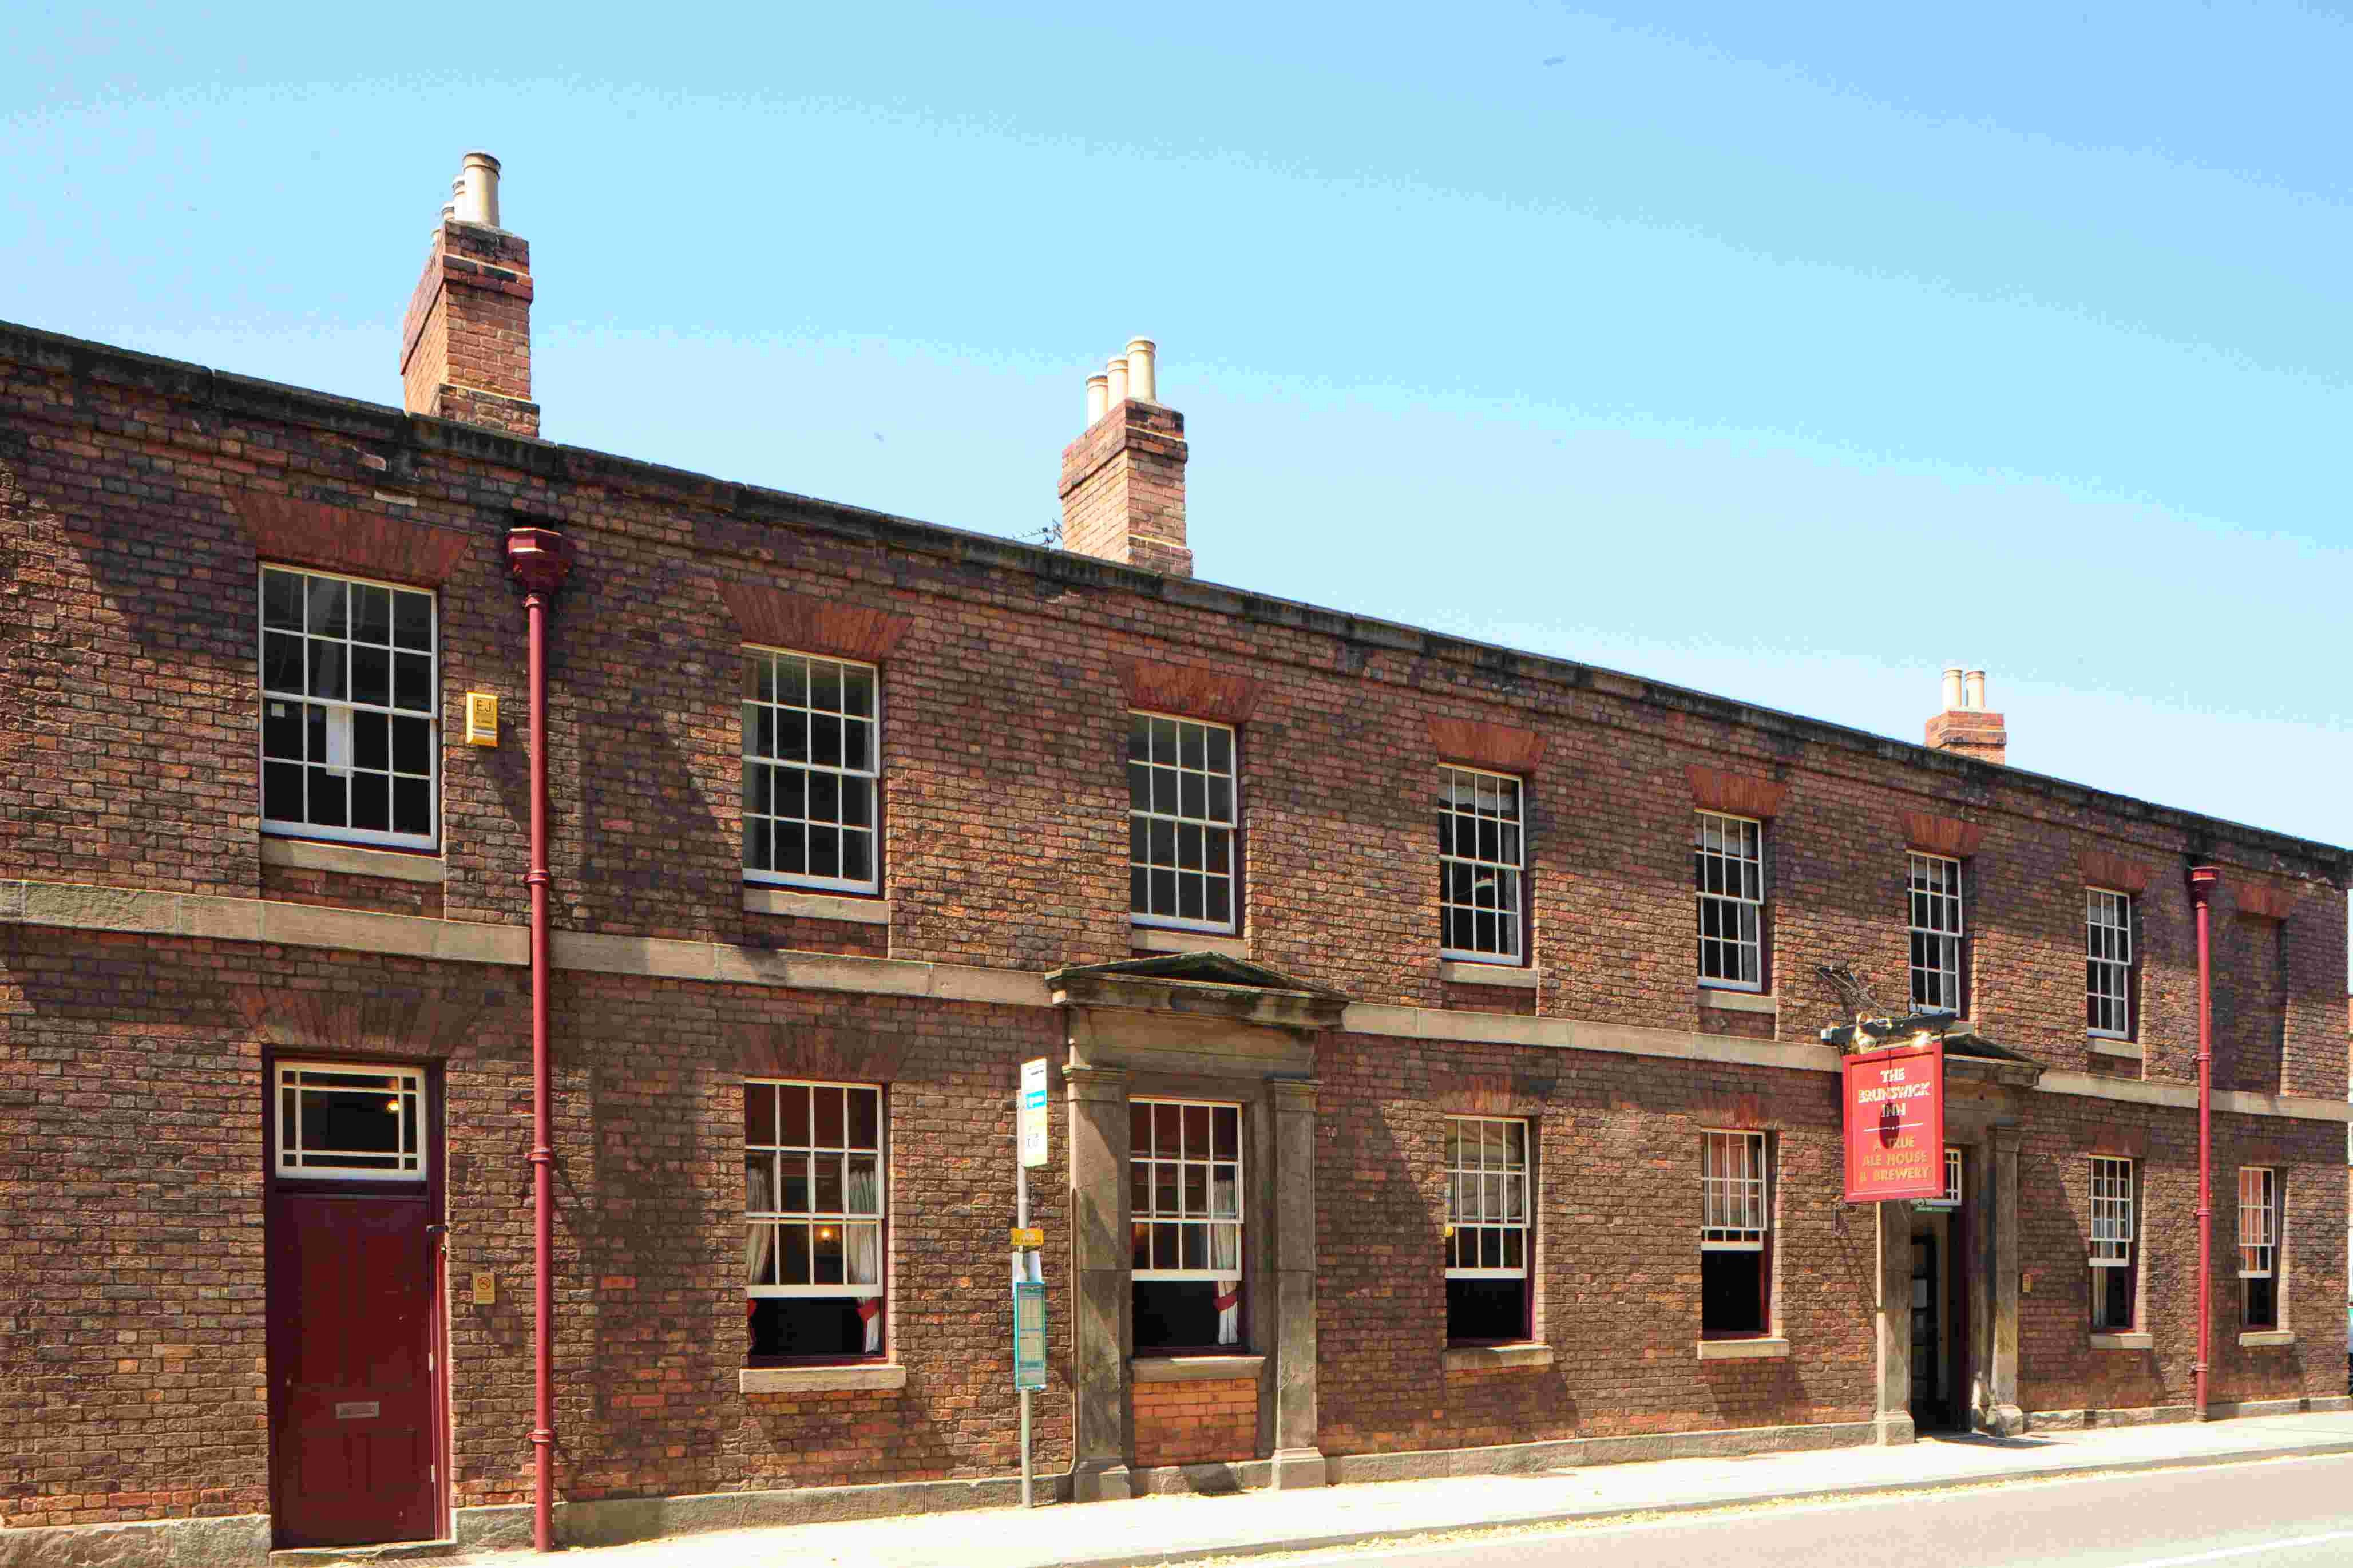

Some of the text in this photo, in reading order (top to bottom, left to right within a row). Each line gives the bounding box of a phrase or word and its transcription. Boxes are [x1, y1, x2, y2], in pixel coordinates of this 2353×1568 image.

[1880, 1067, 1905, 1083] THE
[1858, 1081, 1931, 1103] BRUNSWICK
[1881, 1103, 1906, 1117] INN
[1885, 1135, 1914, 1150] TRUE
[1862, 1151, 1928, 1167] ALE HOUSE
[1873, 1167, 1932, 1182] BREWERY
